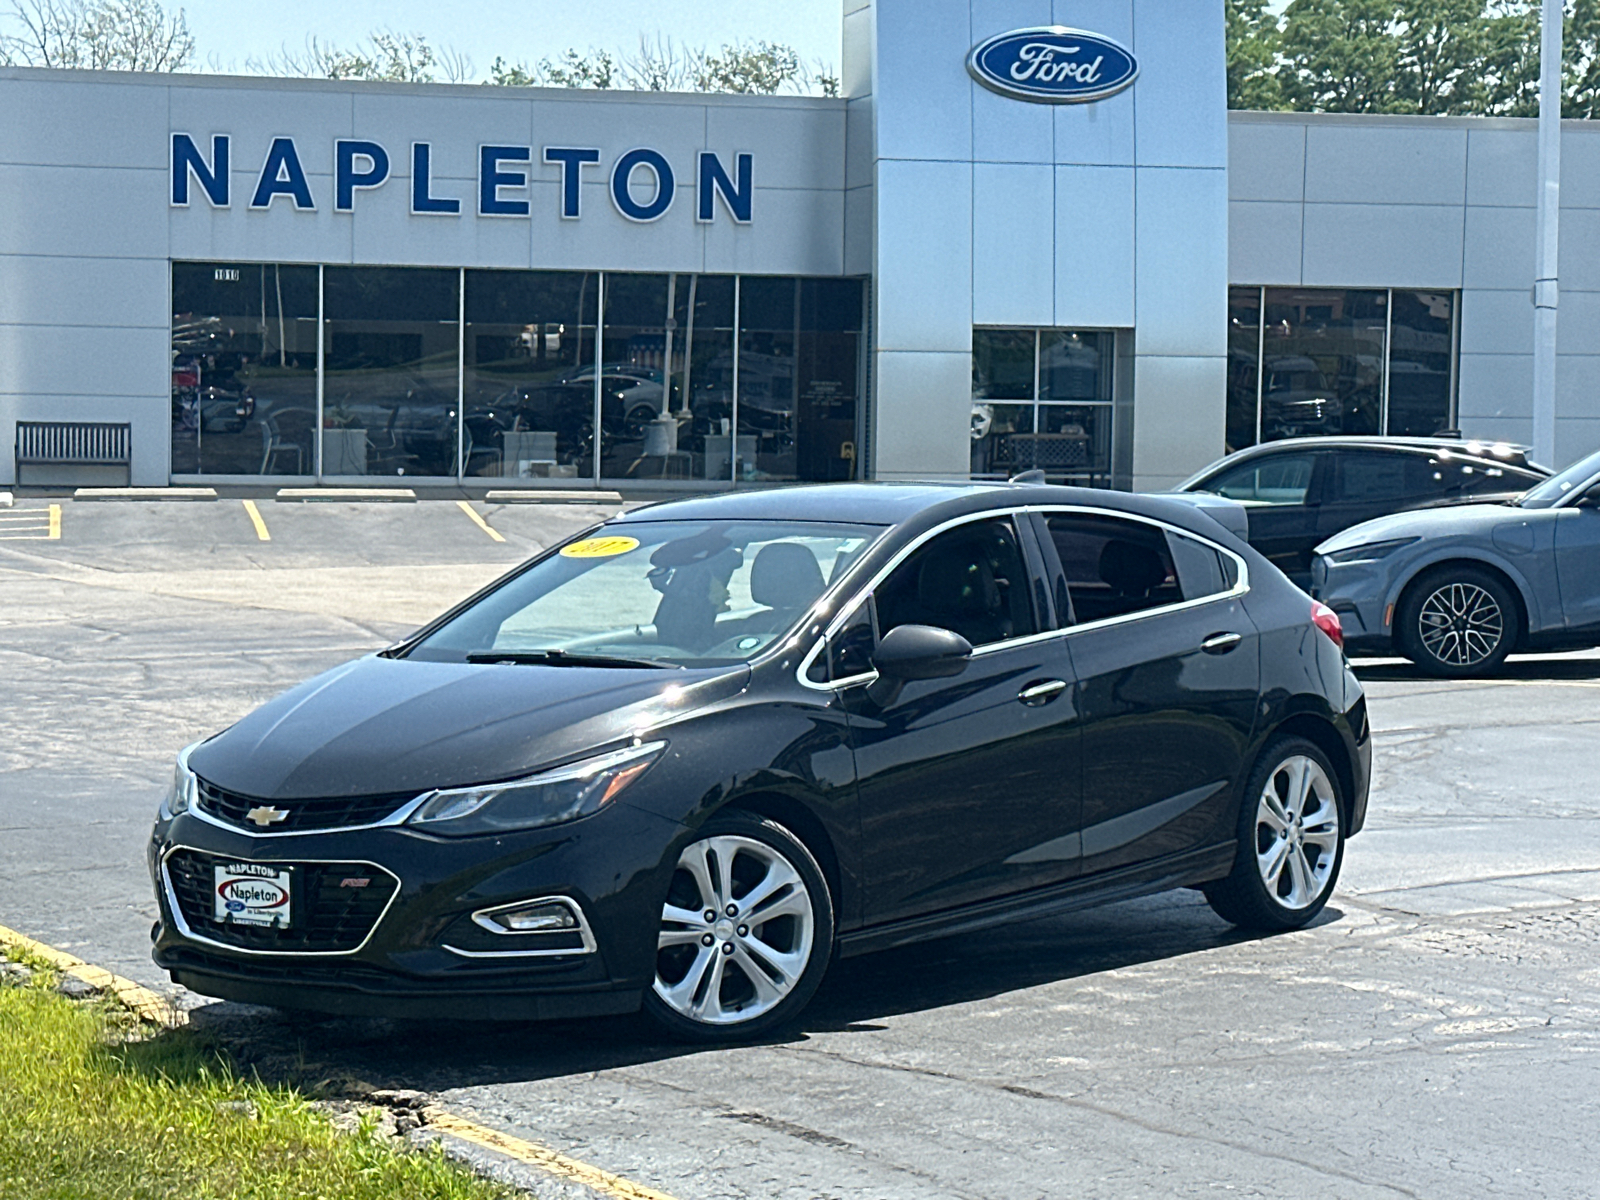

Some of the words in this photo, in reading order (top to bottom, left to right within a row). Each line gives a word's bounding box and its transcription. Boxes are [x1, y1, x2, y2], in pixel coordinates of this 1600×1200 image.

[1010, 43, 1104, 84] Ford
[170, 132, 754, 224] NAPLETON
[214, 269, 240, 281] 1010
[228, 863, 275, 877] NAPLETON
[230, 883, 278, 903] Napleton
